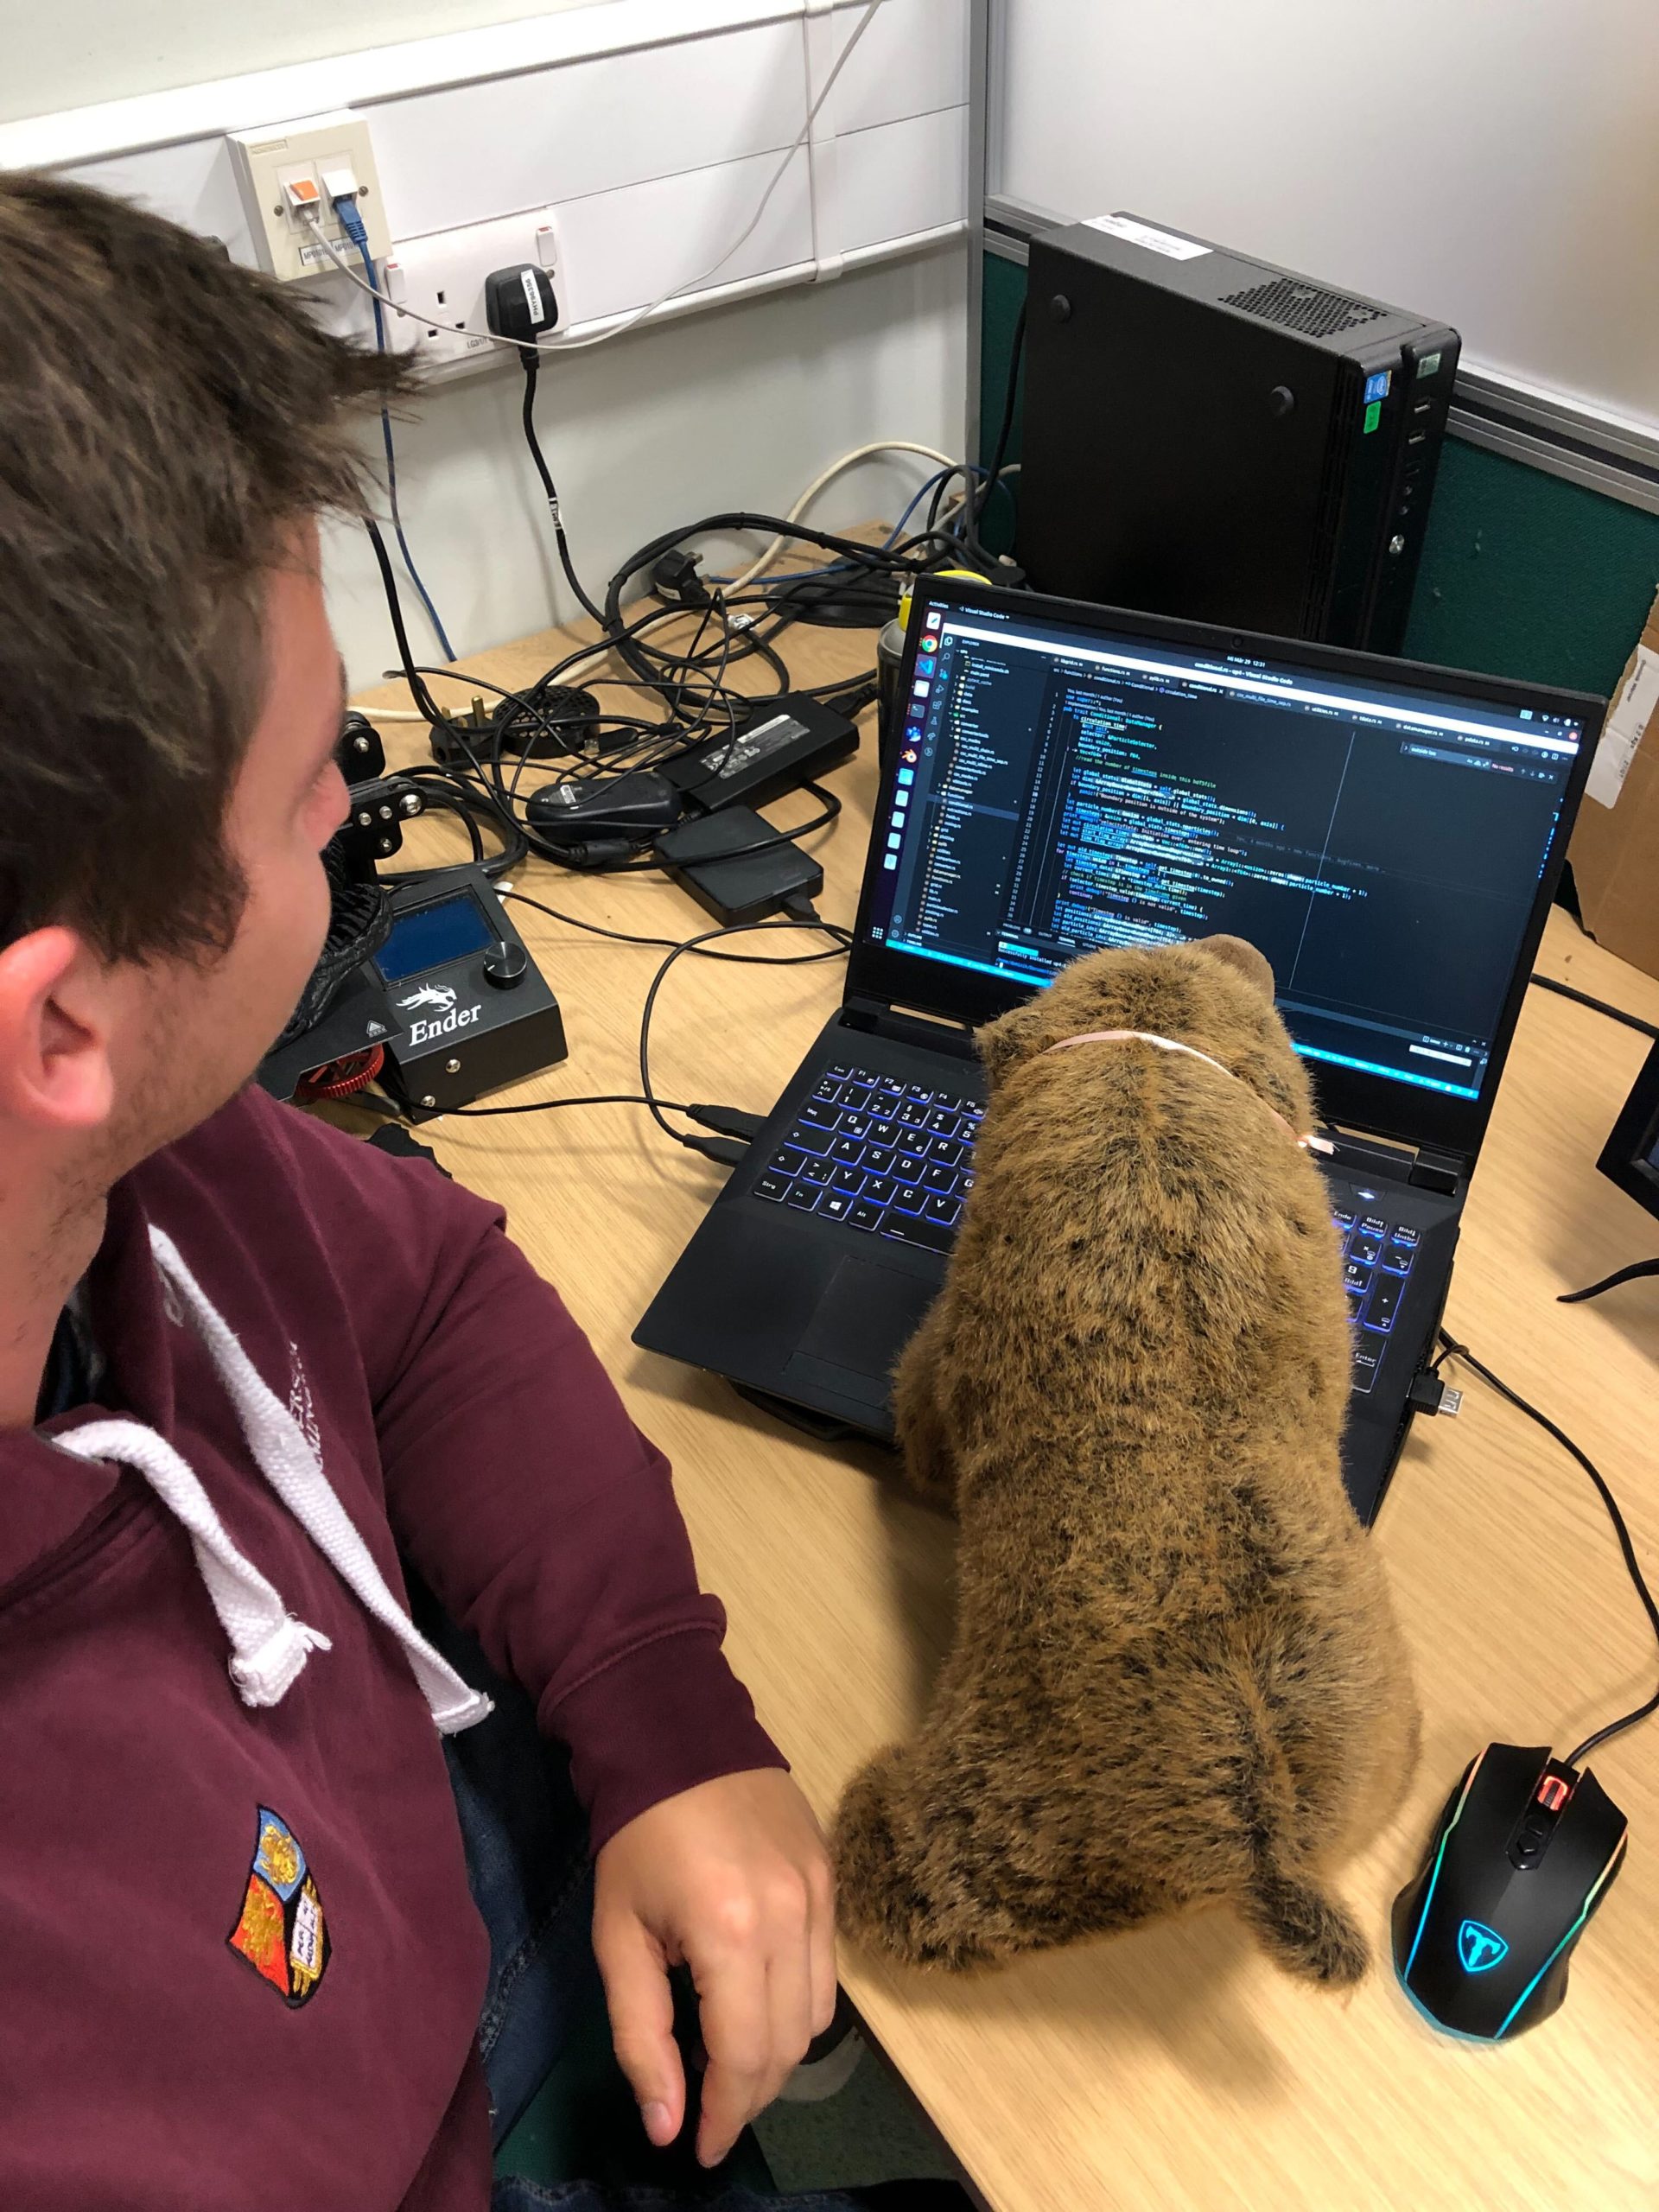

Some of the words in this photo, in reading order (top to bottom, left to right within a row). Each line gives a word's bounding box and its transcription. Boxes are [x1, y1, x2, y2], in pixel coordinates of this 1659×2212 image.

[1080, 729, 1105, 738] selector:
[1124, 798, 1147, 807] position
[1187, 838, 1211, 848] entering
[410, 1004, 481, 1046] Ender
